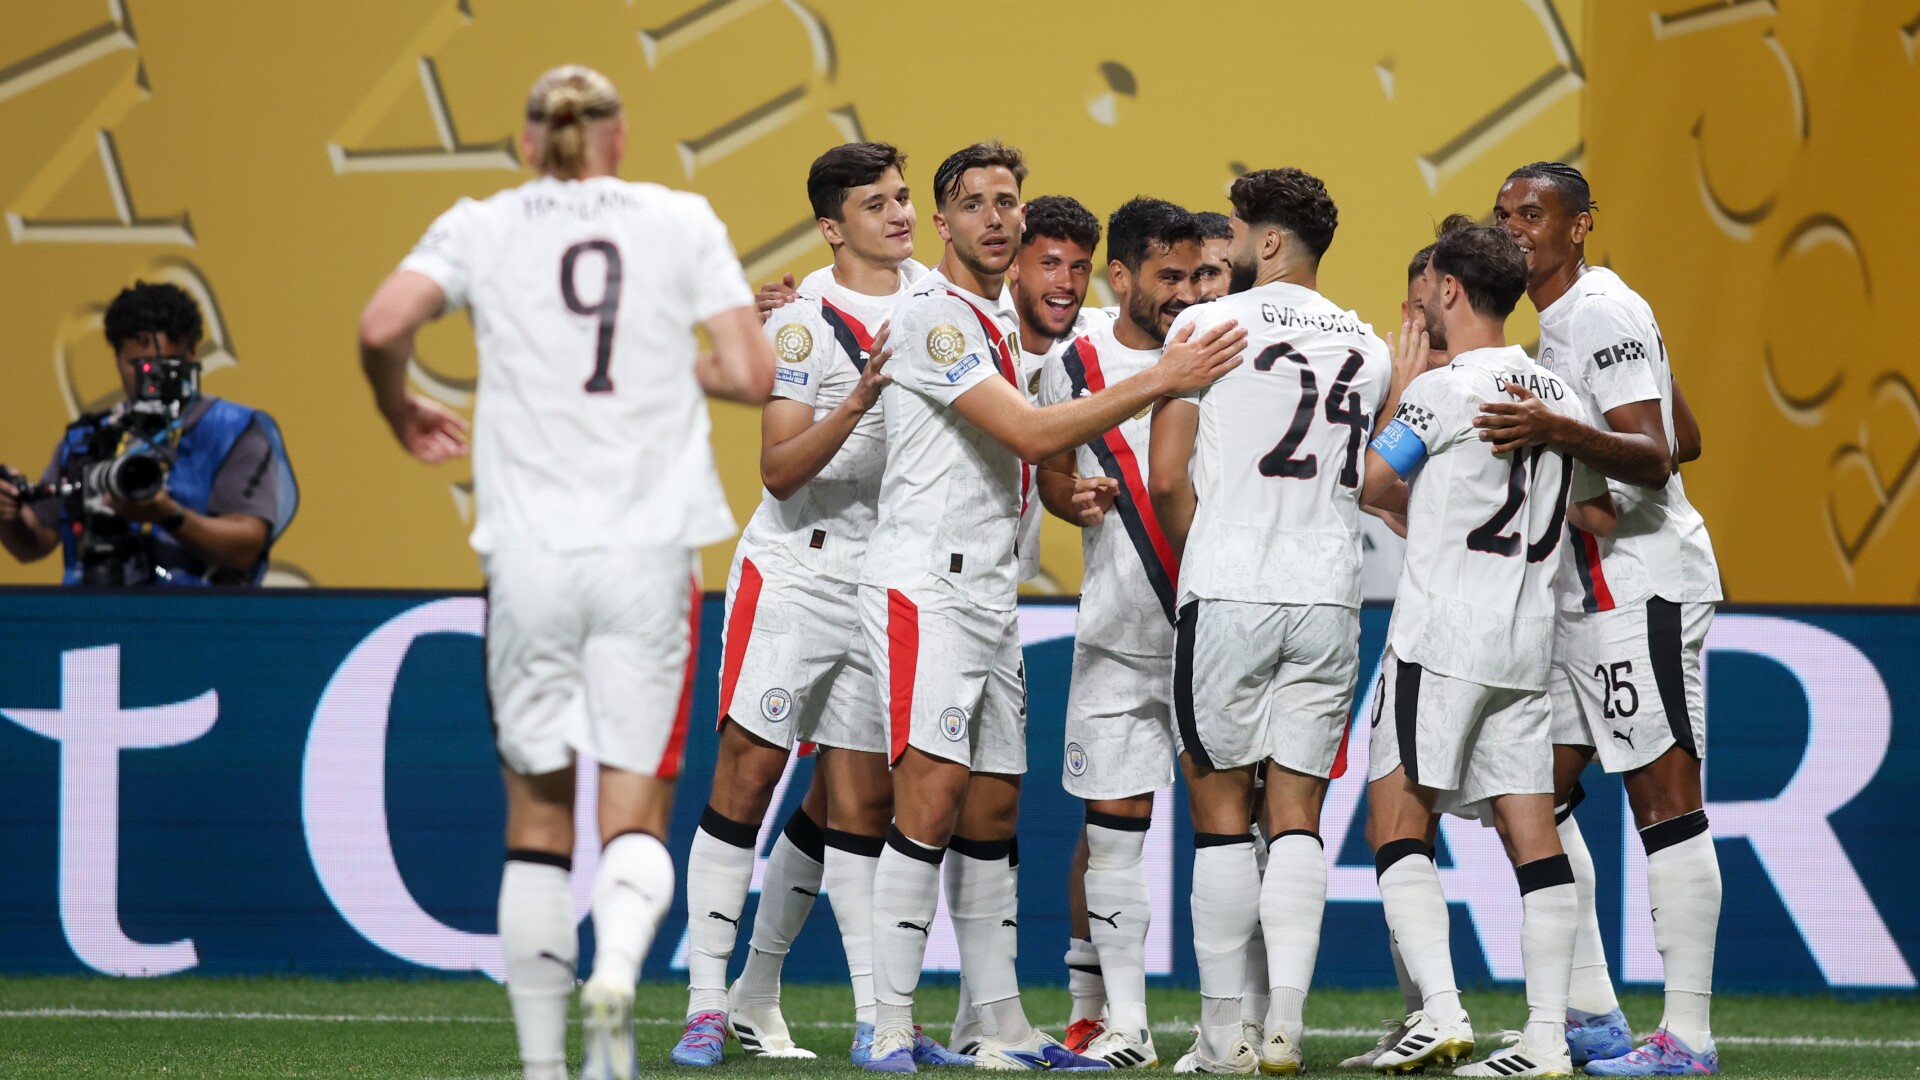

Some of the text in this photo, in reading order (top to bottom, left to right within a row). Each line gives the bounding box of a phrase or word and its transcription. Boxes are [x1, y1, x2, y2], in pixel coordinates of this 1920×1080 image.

[560, 240, 622, 393] 9
[1261, 303, 1366, 336] GVARDIOL
[782, 351, 798, 361] FIFA
[944, 350, 960, 362] FIFA
[1490, 370, 1564, 401] BNARD
[1253, 341, 1370, 488] 24
[1594, 660, 1639, 719] 25
